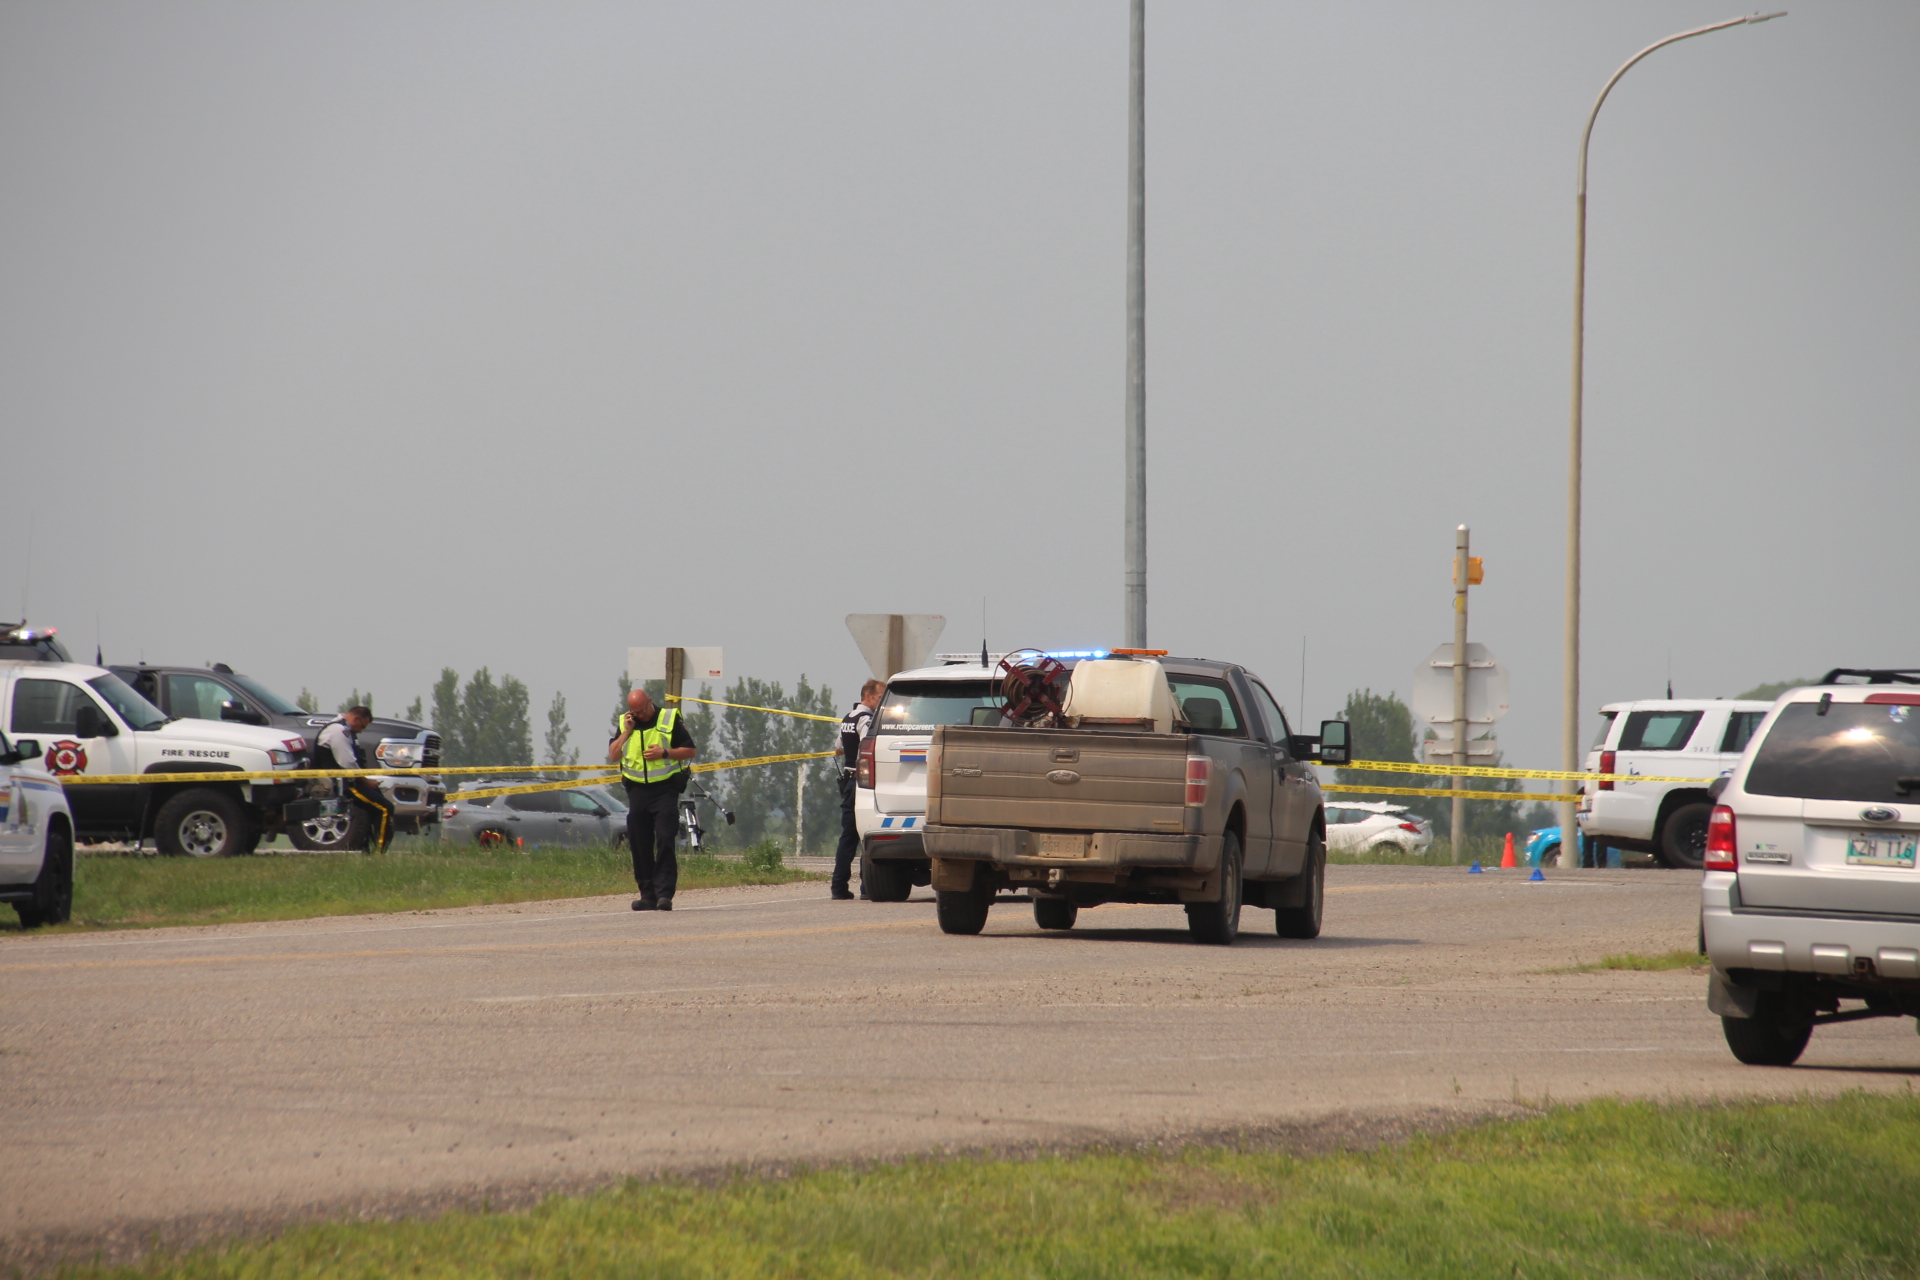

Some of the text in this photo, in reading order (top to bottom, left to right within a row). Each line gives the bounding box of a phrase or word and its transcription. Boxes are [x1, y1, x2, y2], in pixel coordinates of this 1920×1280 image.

[161, 749, 230, 758] FIRE RESCUE
[1888, 841, 1912, 859] 116
